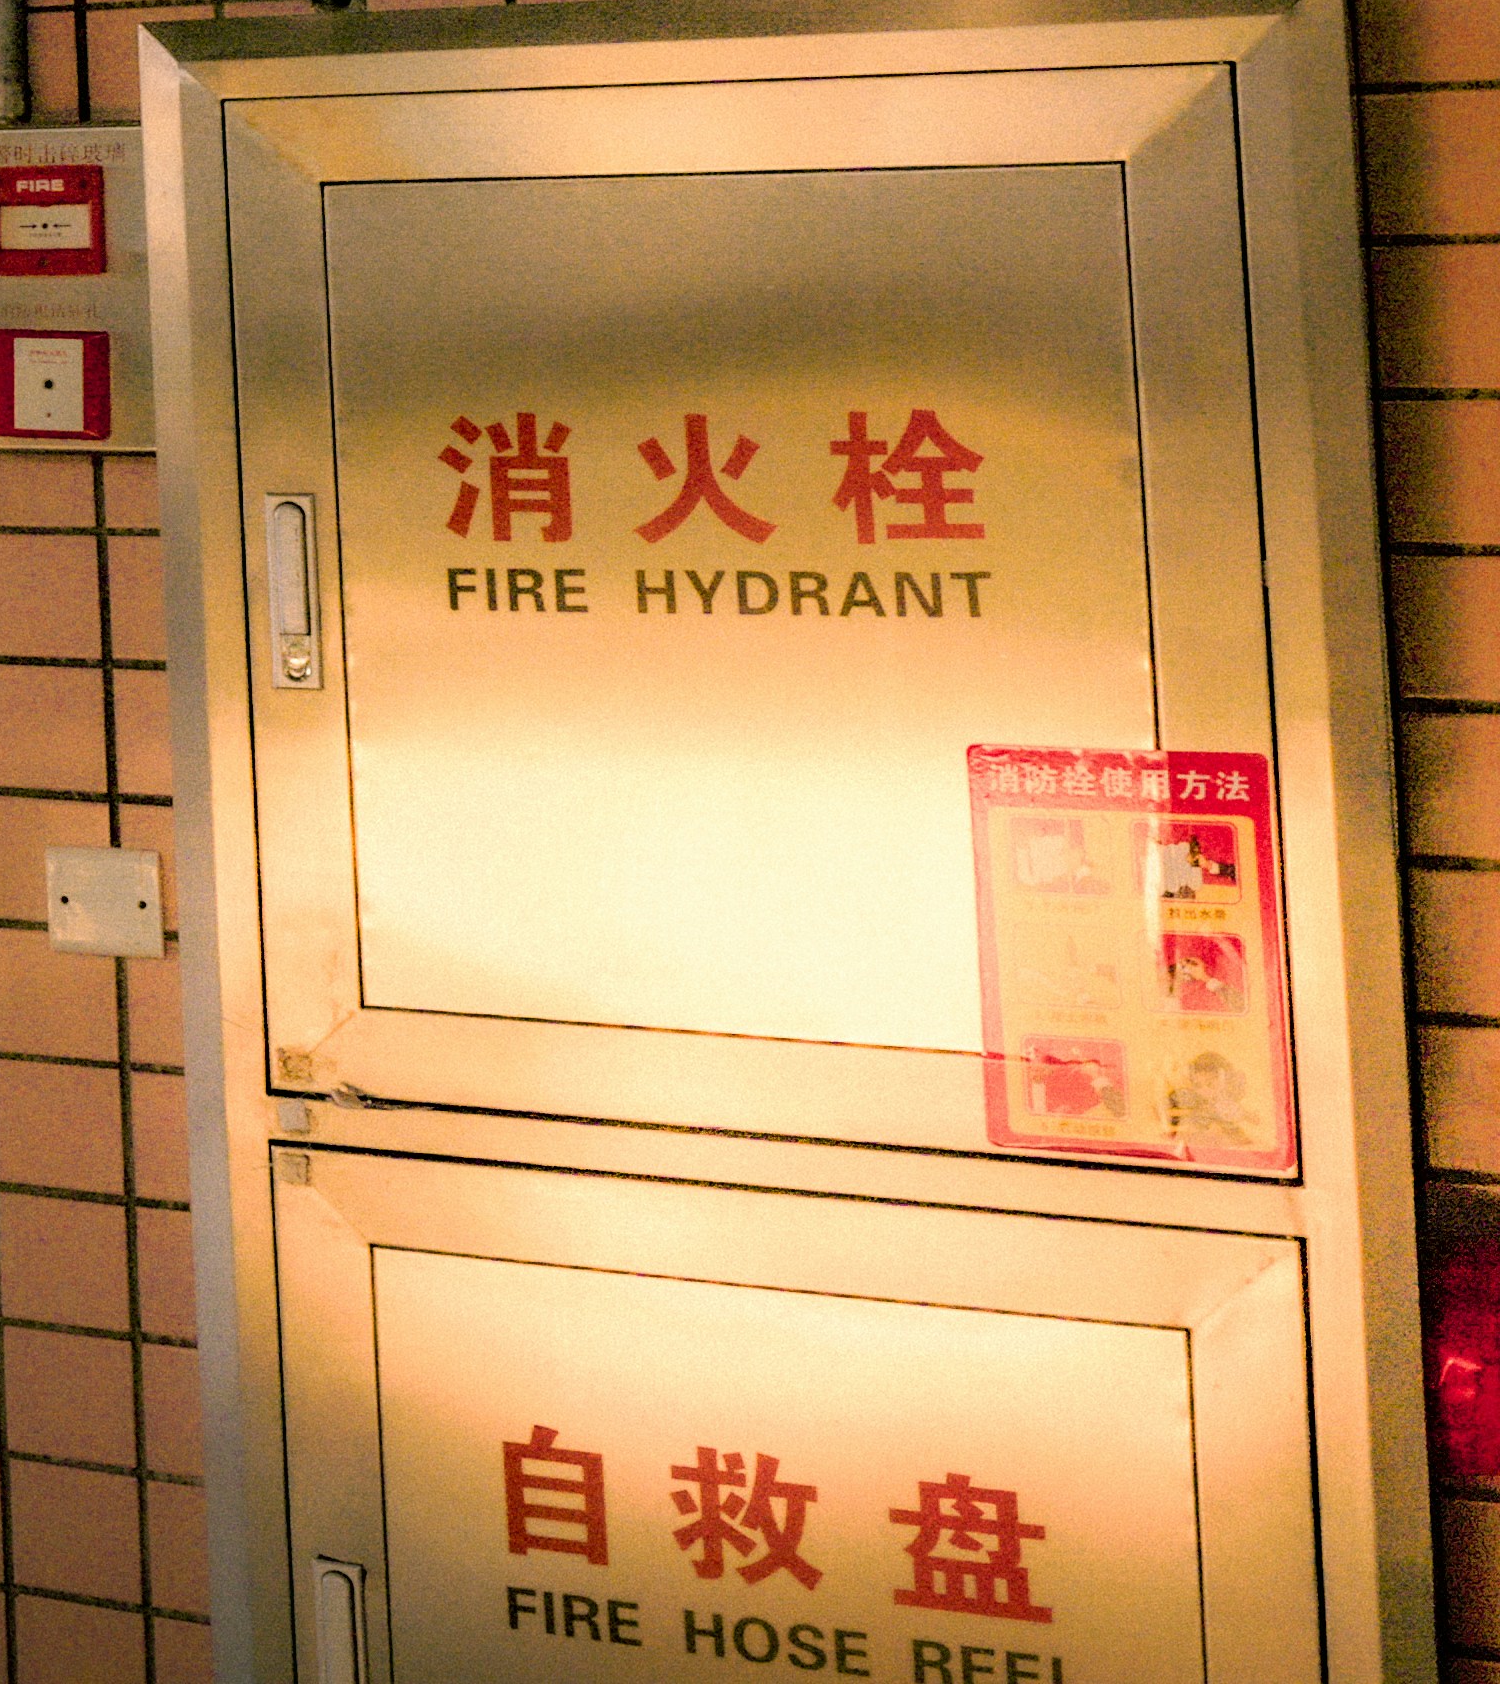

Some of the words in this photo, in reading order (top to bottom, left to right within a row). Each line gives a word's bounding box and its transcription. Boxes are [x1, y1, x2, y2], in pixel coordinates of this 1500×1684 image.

[16, 178, 65, 193] FIRE
[437, 408, 985, 545] 消火栓
[446, 567, 589, 614] FIRE
[636, 568, 992, 619] HYDRANT
[989, 763, 1250, 802] 消防栓使用方法
[502, 1424, 1053, 1624] 自救盘
[505, 1586, 643, 1647] FIRE
[683, 1609, 871, 1677] HOSE
